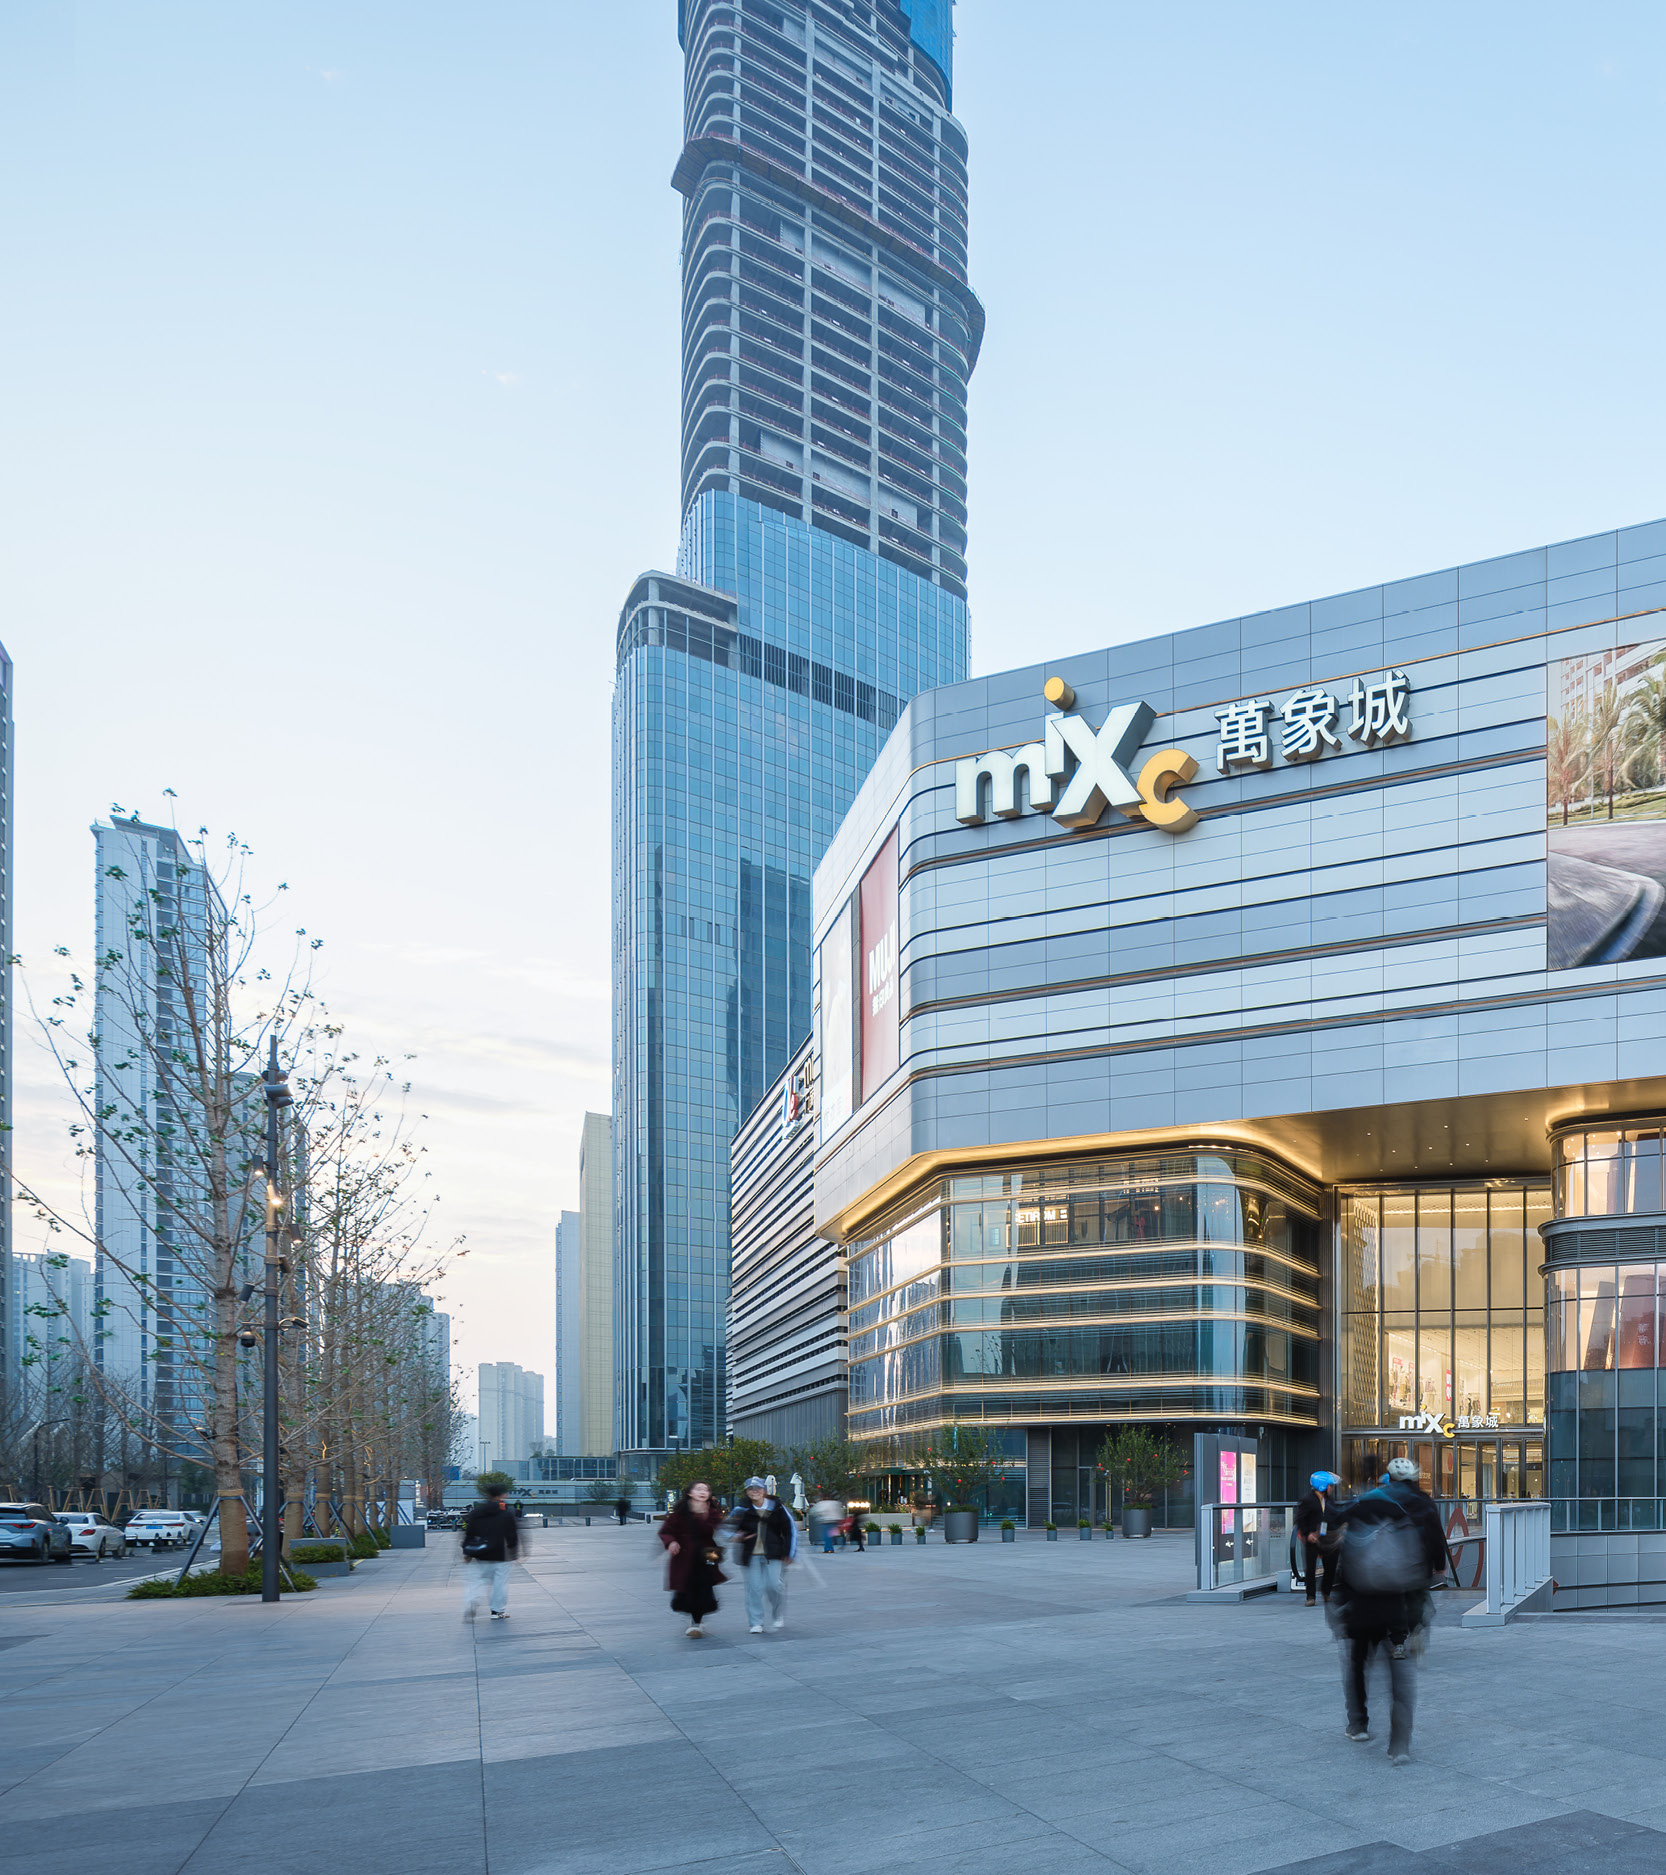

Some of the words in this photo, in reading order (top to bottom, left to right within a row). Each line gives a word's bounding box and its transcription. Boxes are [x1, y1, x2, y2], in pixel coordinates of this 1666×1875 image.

[1213, 670, 1412, 776] 萬象城
[868, 919, 896, 996] MUJI
[1457, 1414, 1499, 1429] 萬象城
